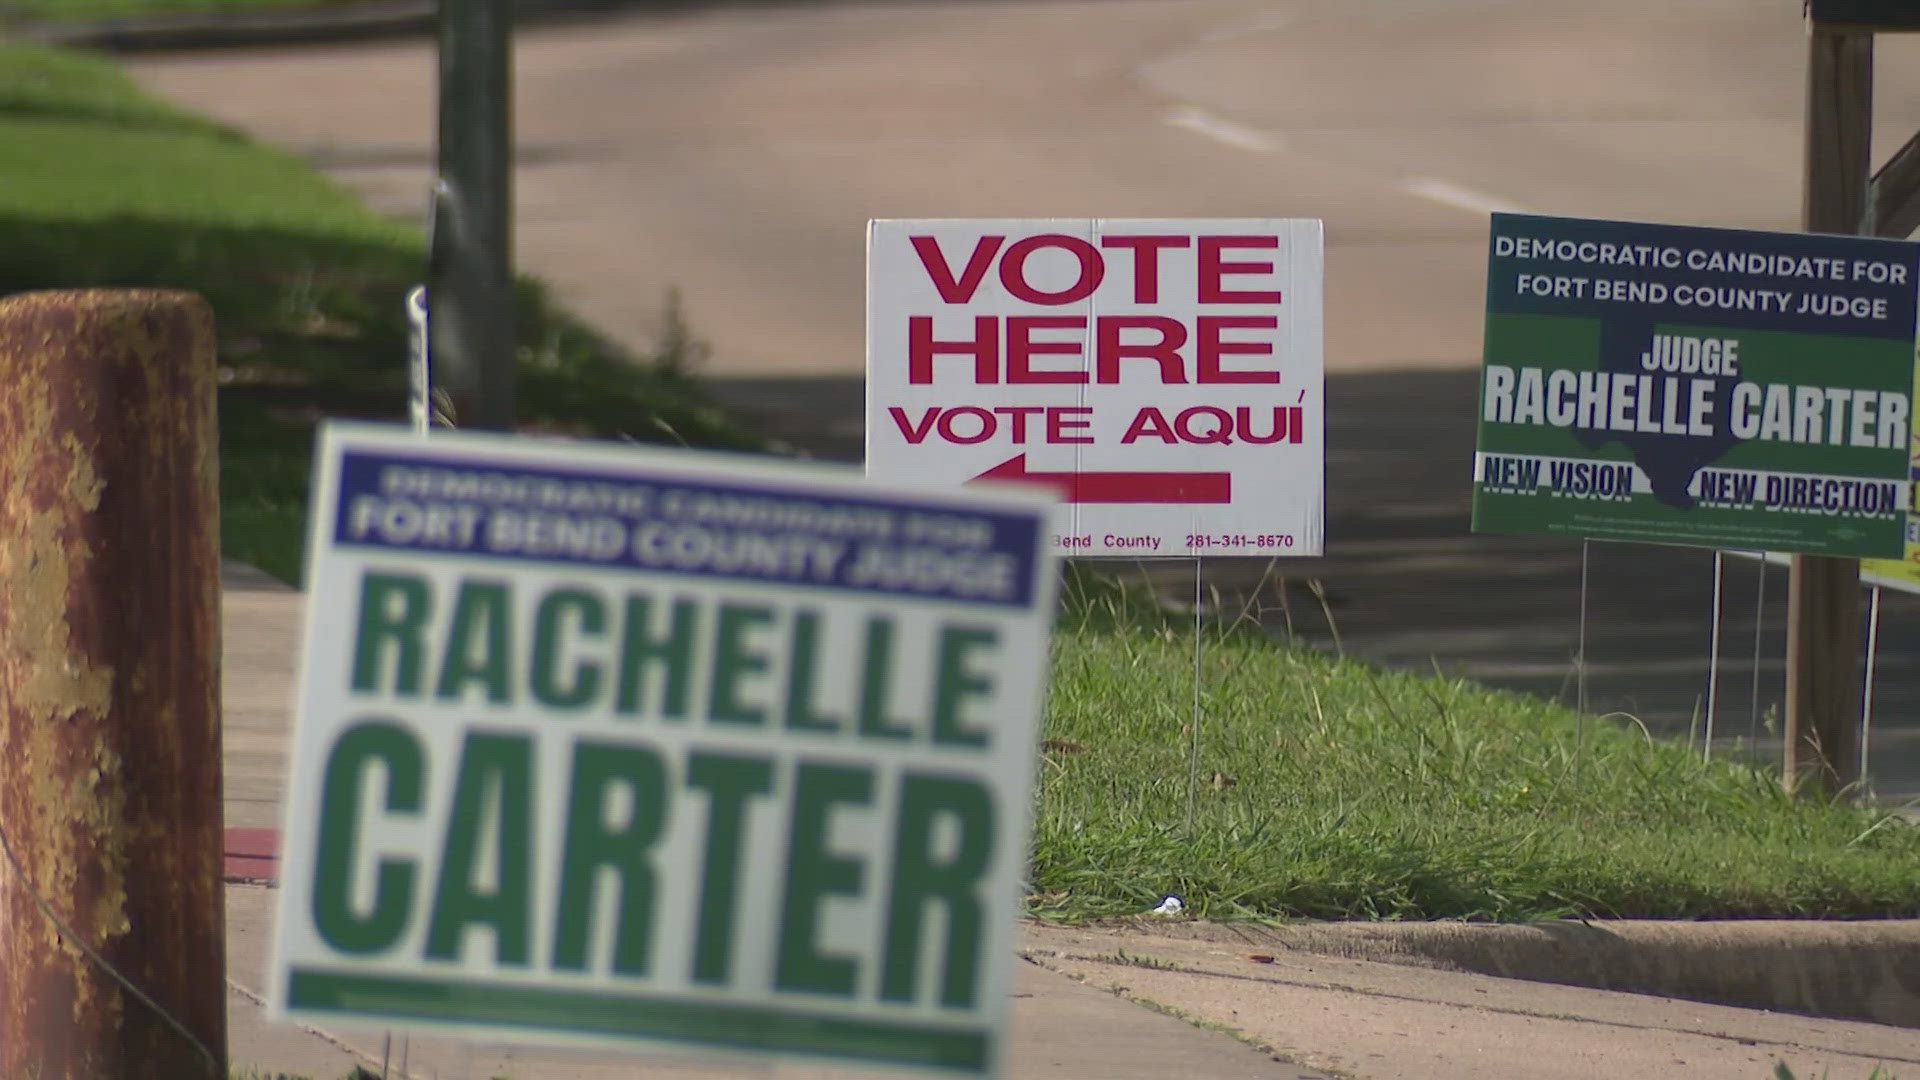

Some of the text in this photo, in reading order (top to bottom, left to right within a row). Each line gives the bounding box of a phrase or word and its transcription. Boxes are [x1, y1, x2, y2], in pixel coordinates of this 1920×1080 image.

[908, 234, 1281, 306] VOTE
[1494, 236, 1907, 285] DEMOCRATIC CANDIDATE FOR
[1517, 274, 1888, 319] FORT BEND COUNTY JUDGE
[909, 315, 1281, 384] HERE
[1641, 334, 1739, 376] JUDGE
[888, 389, 1306, 446] VOTE AQUÍ
[1483, 365, 1909, 450] RACHELLE CARTER
[381, 464, 650, 512] DEMOCRATIC
[1483, 455, 1634, 502] NEW VISION
[1699, 470, 1757, 510] NEW
[1764, 475, 1898, 520] DIRECTION
[350, 494, 1018, 597] FORT BEND COUNTY JUDGE
[1103, 534, 1161, 549] County
[1185, 534, 1294, 547] 281-341-8670
[349, 569, 1004, 748] RACHELLE
[310, 720, 997, 1012] CARTER
